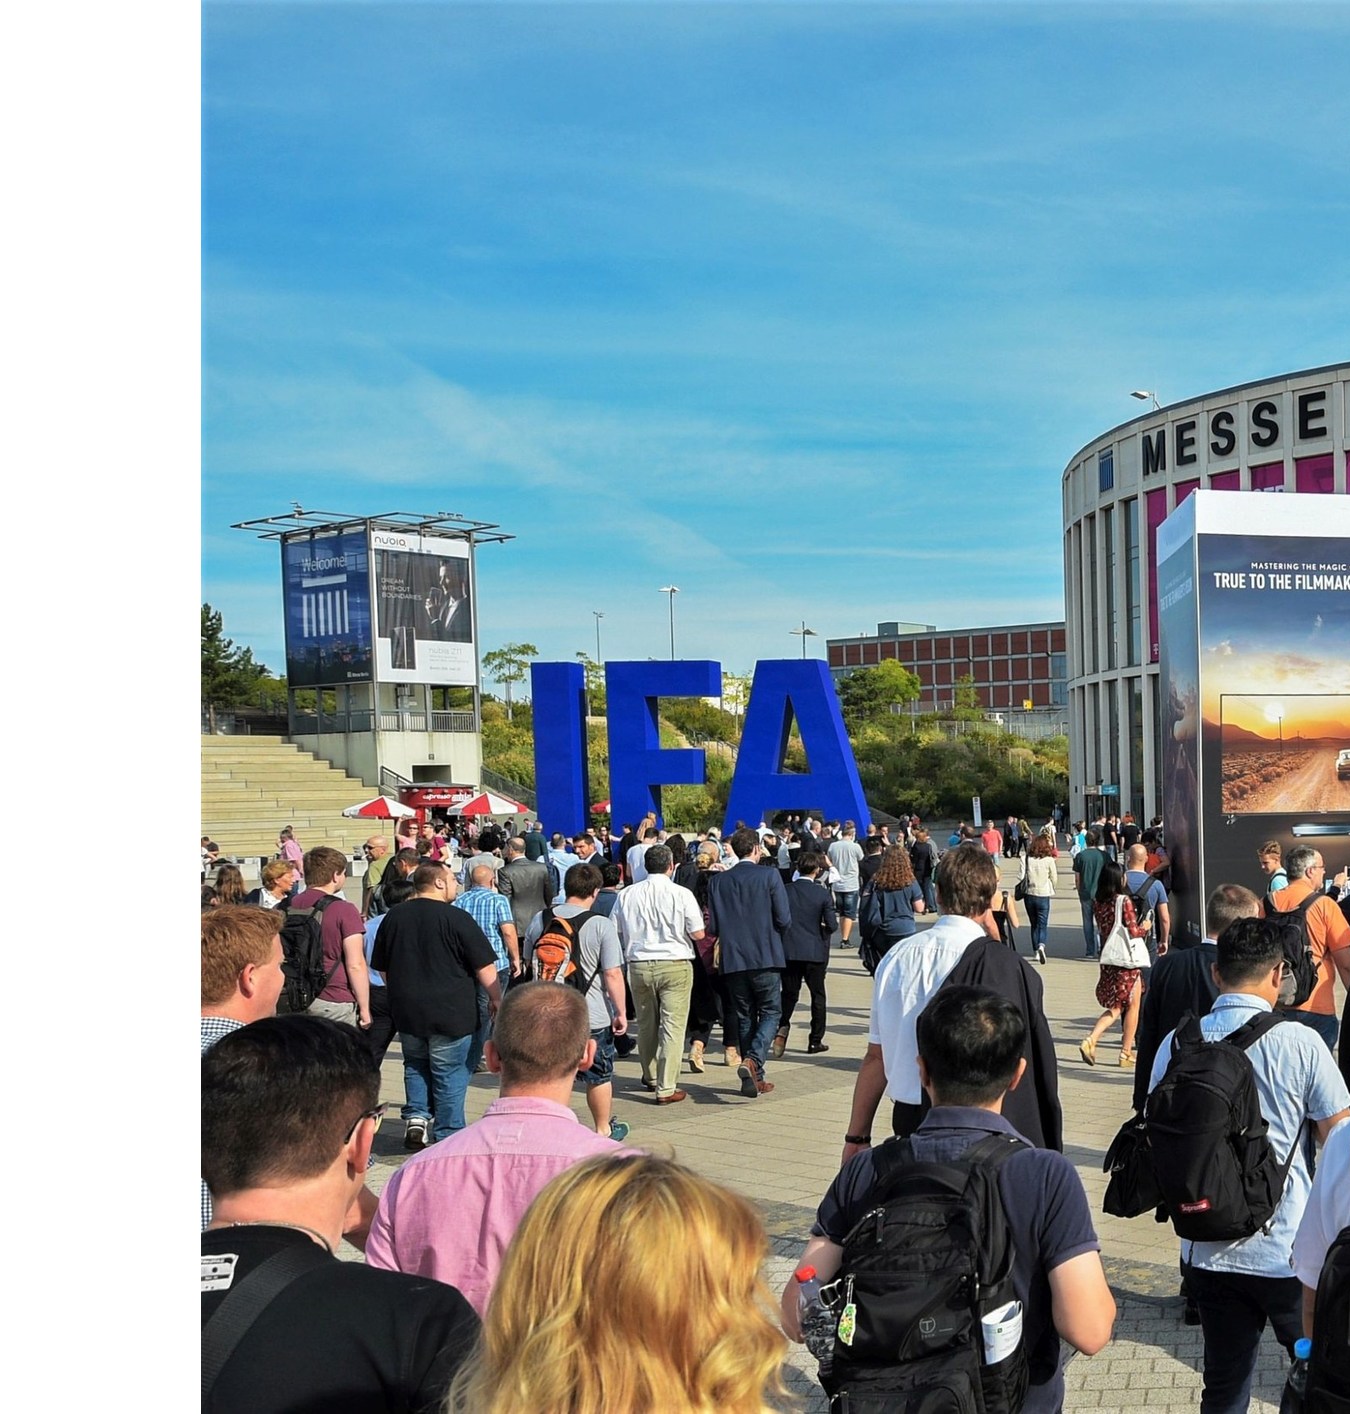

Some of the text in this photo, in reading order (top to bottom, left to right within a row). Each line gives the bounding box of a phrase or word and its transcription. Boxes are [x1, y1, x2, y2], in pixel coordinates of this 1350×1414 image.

[1142, 391, 1327, 476] MESSE
[1213, 572, 1246, 589] TRUE
[1249, 573, 1265, 589] TO
[1268, 574, 1292, 590] THE
[1251, 562, 1299, 571] MASTERING
[1302, 563, 1317, 571] THE
[1319, 563, 1347, 571] MAGIC
[530, 659, 872, 842] IFA
